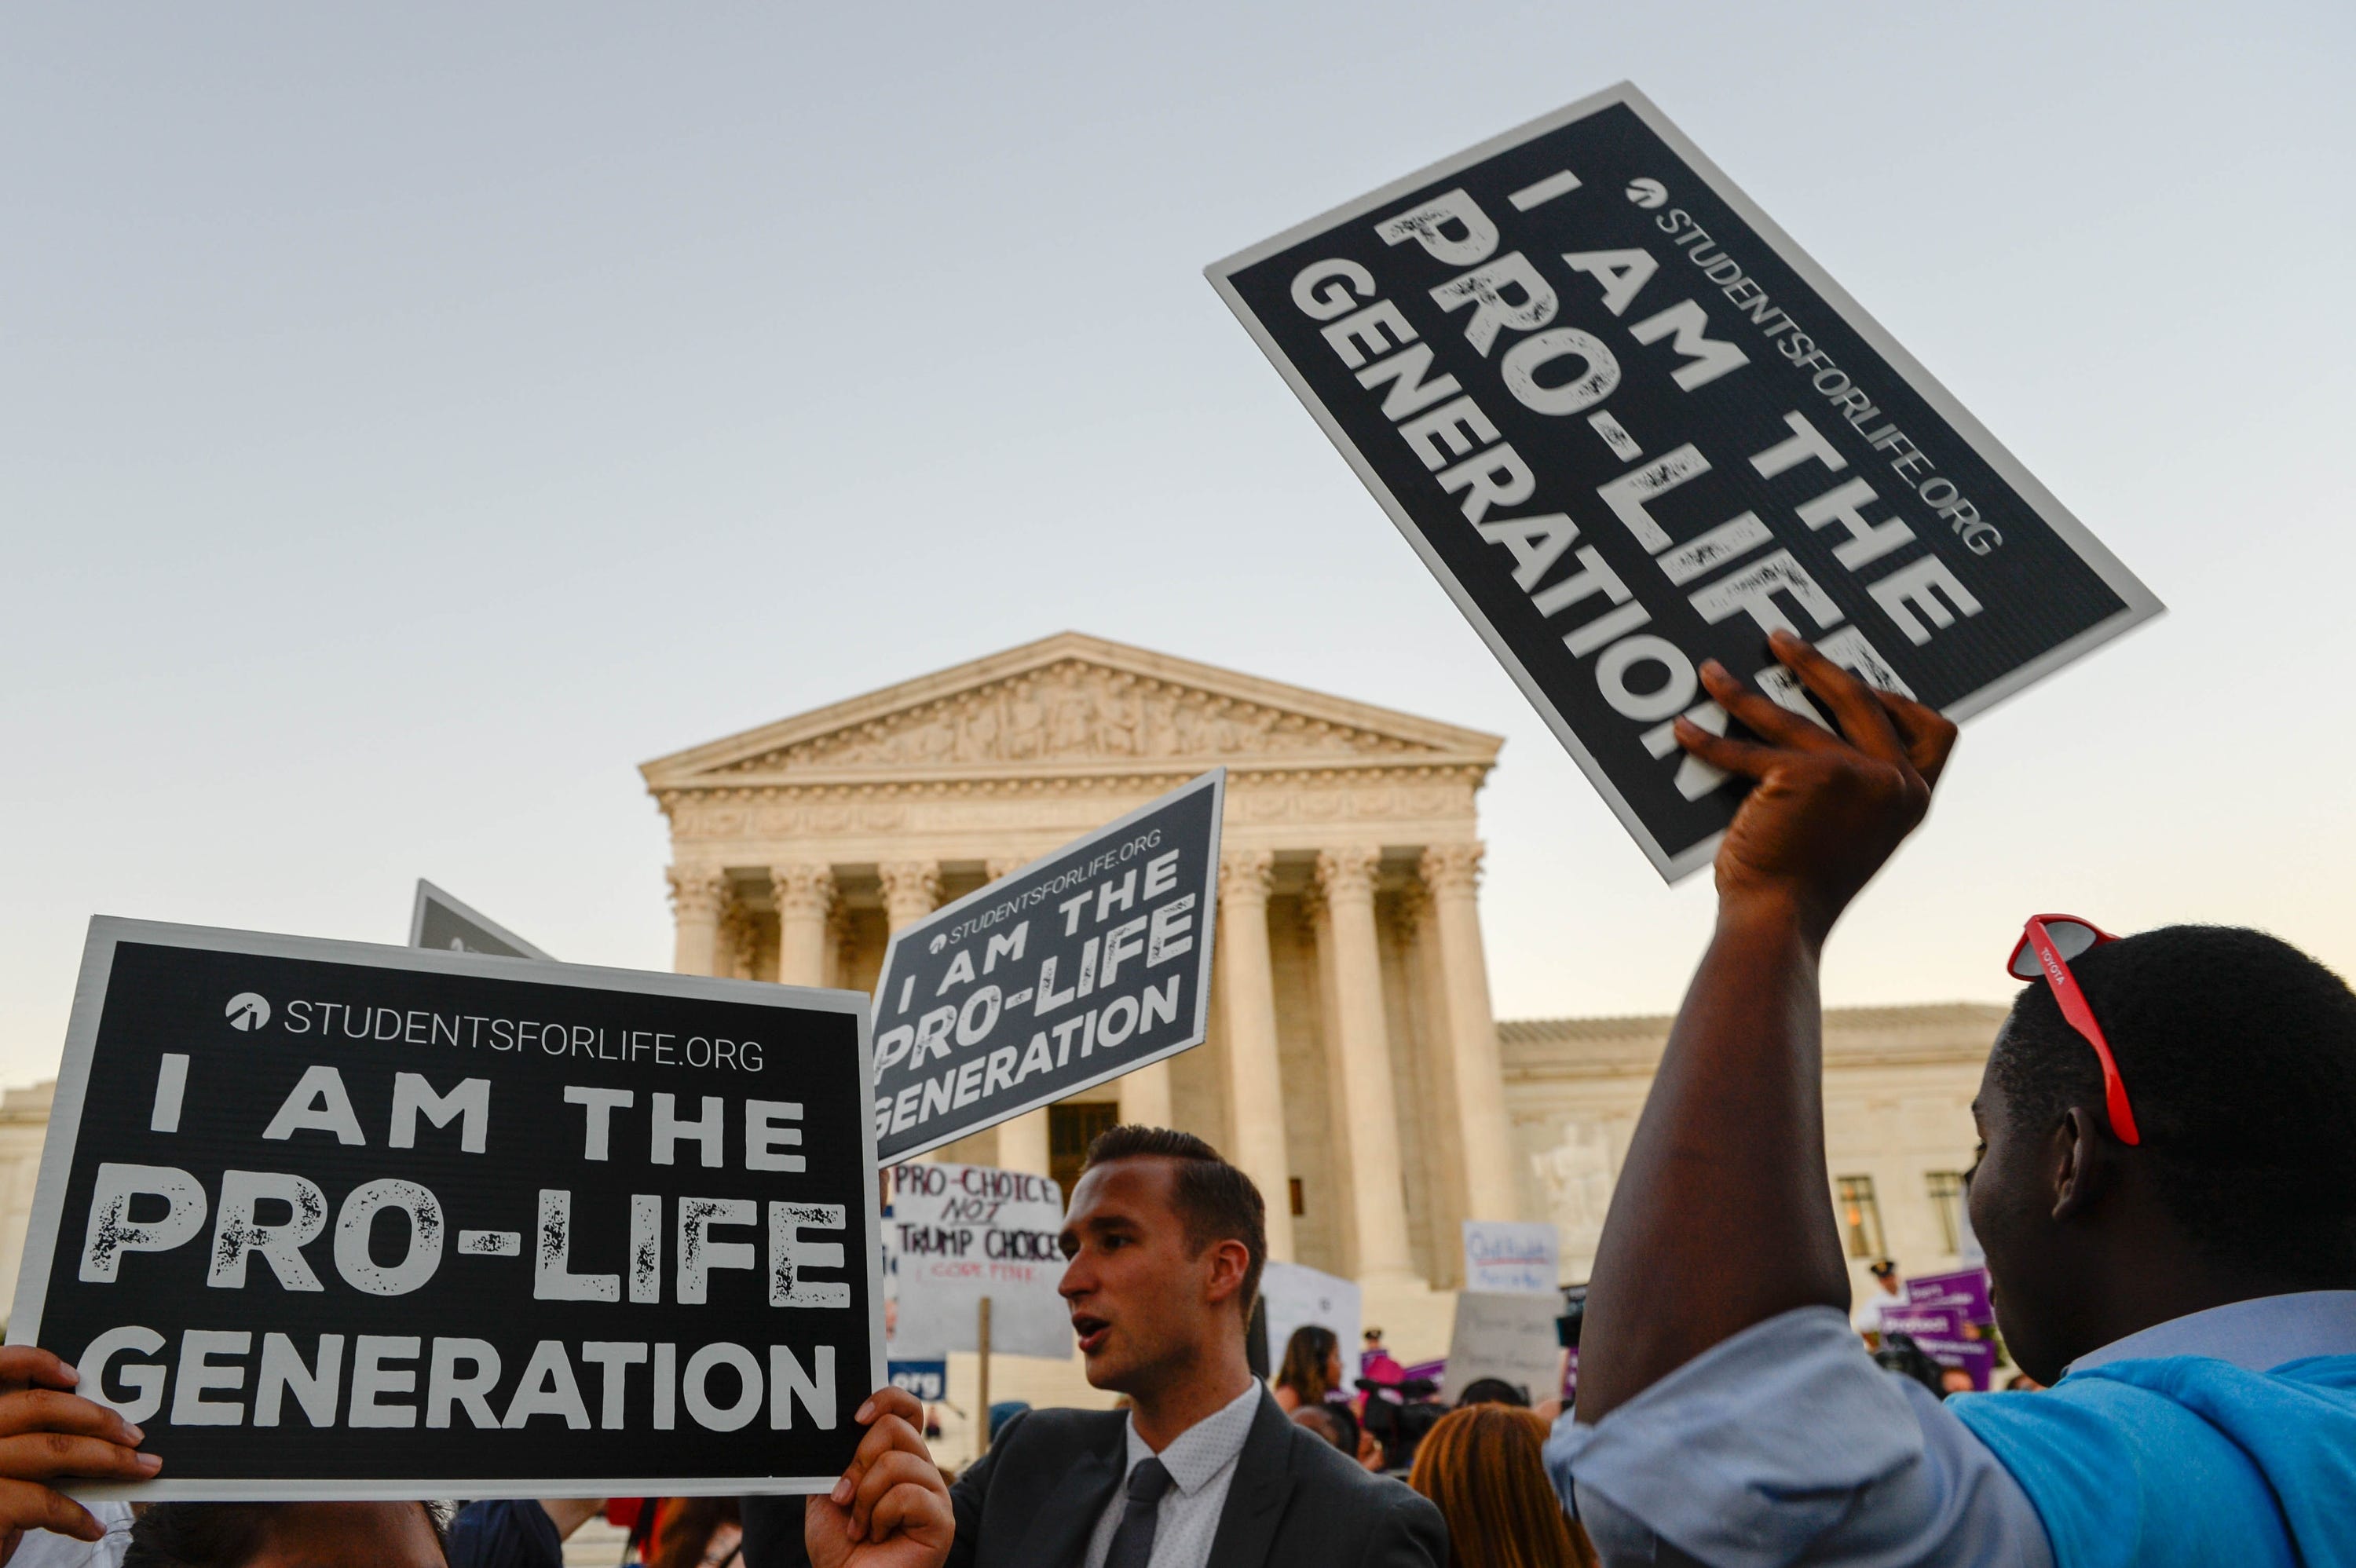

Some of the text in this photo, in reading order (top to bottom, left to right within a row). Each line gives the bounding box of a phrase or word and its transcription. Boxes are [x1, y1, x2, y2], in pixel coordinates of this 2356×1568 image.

[1507, 169, 1985, 647] I AM THE
[1655, 207, 2003, 557] STUDENTSFORLIFE.ORG
[897, 848, 1180, 1014] I AM THE
[949, 828, 1162, 945] STUDENTSFORLIFE.ORG
[873, 893, 1195, 1086] PRO-LIFE
[2041, 946, 2065, 985] TOYOTA
[284, 1000, 764, 1073] STUDENTSFORLIFE.ORG
[150, 1053, 807, 1173] I AM THE
[78, 1162, 851, 1309] PRO-LIFE
[896, 1223, 973, 1256] TRUMP
[941, 1197, 1008, 1223] NOT
[75, 1325, 837, 1433] GENERATION
